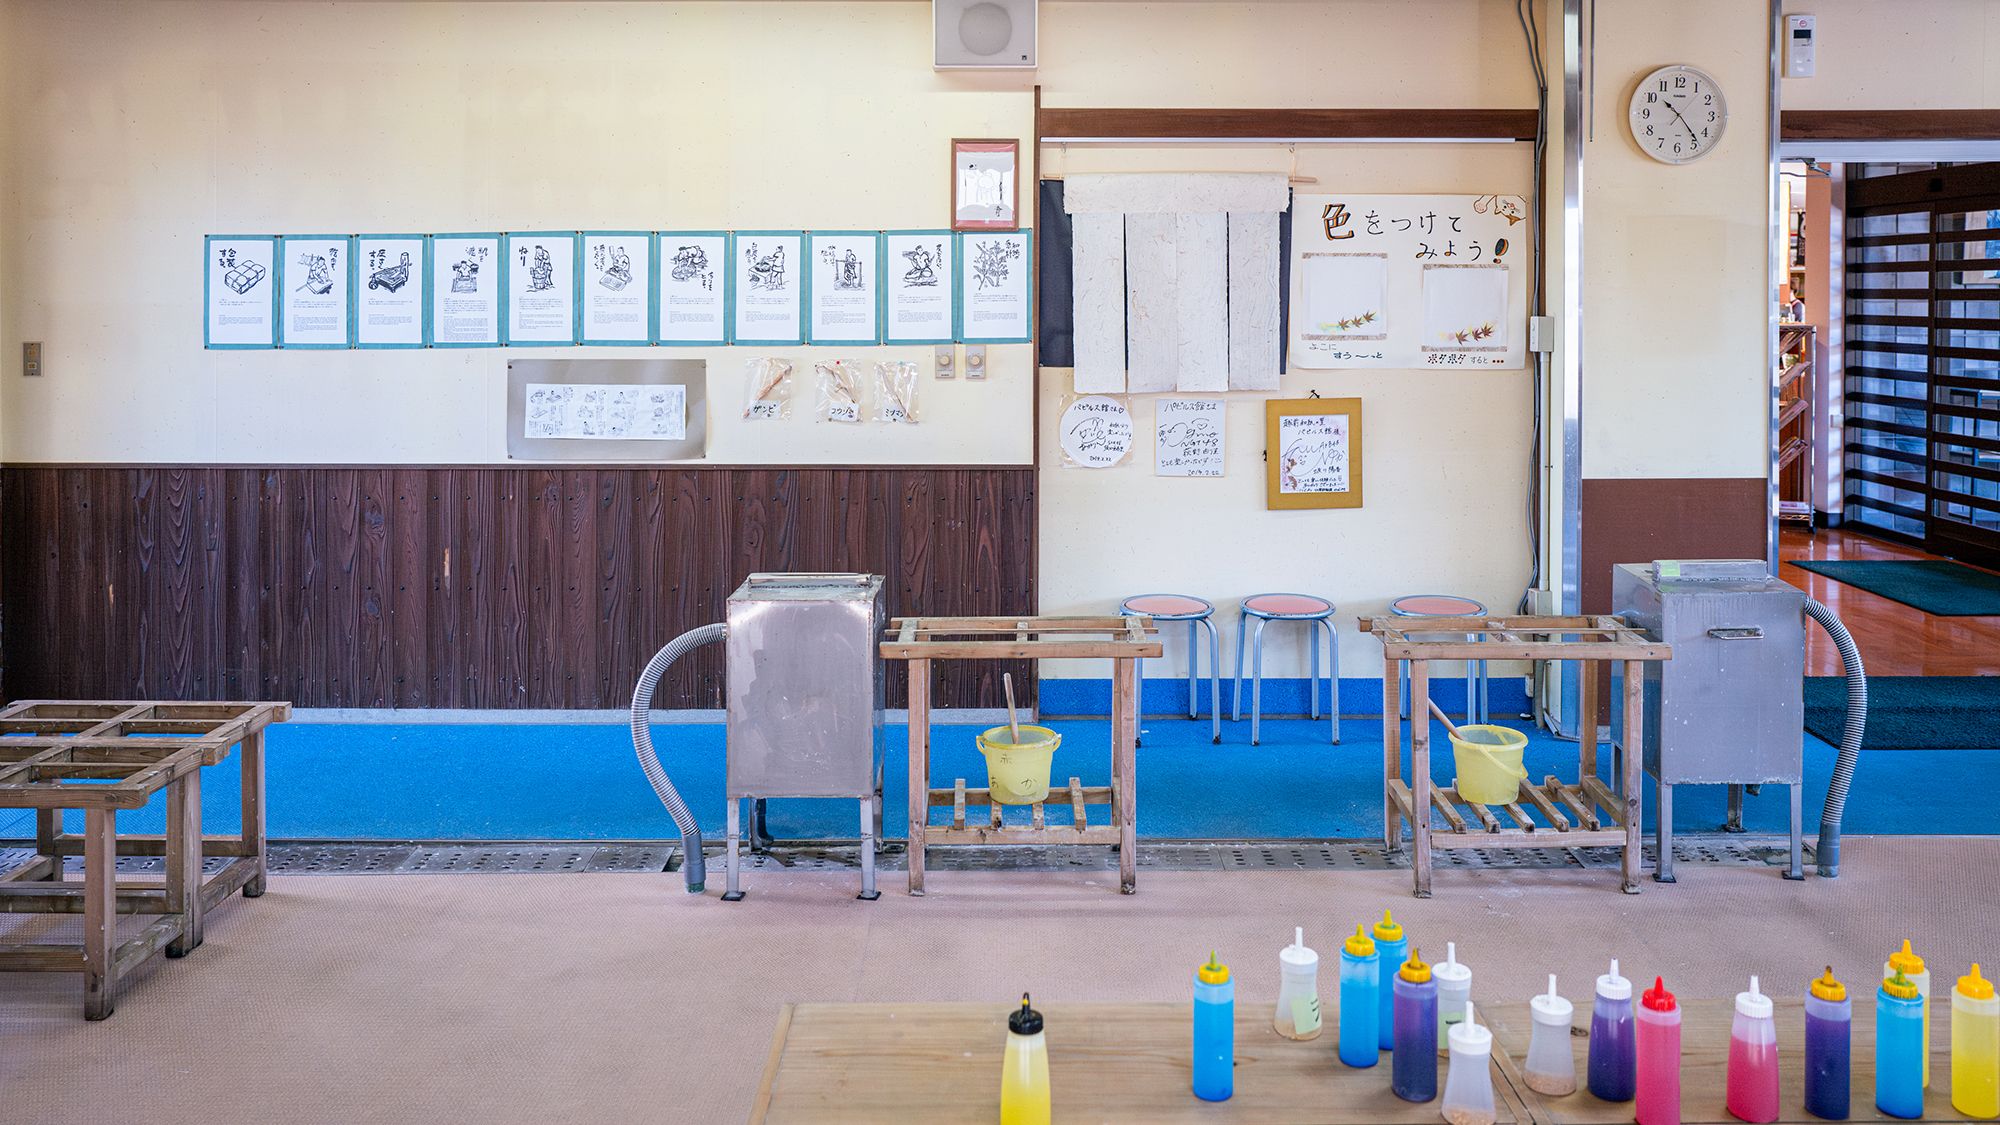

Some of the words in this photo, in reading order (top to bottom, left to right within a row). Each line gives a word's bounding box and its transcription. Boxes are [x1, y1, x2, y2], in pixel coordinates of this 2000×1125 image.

[1659, 81, 1667, 92] 11
[1674, 77, 1686, 88] 12
[1694, 82, 1698, 93] 1
[1647, 92, 1657, 103] 10
[1704, 94, 1712, 105] 2
[1642, 108, 1650, 119] 9
[1707, 111, 1715, 122] 3
[1646, 125, 1654, 136] 8
[1701, 127, 1708, 137] 4
[1658, 138, 1664, 148] 7
[1673, 143, 1681, 153] 6
[1690, 138, 1698, 150] 5
[1322, 203, 1462, 241] 色をつけて
[519, 246, 528, 266] ねり
[1309, 343, 1337, 351] よこに
